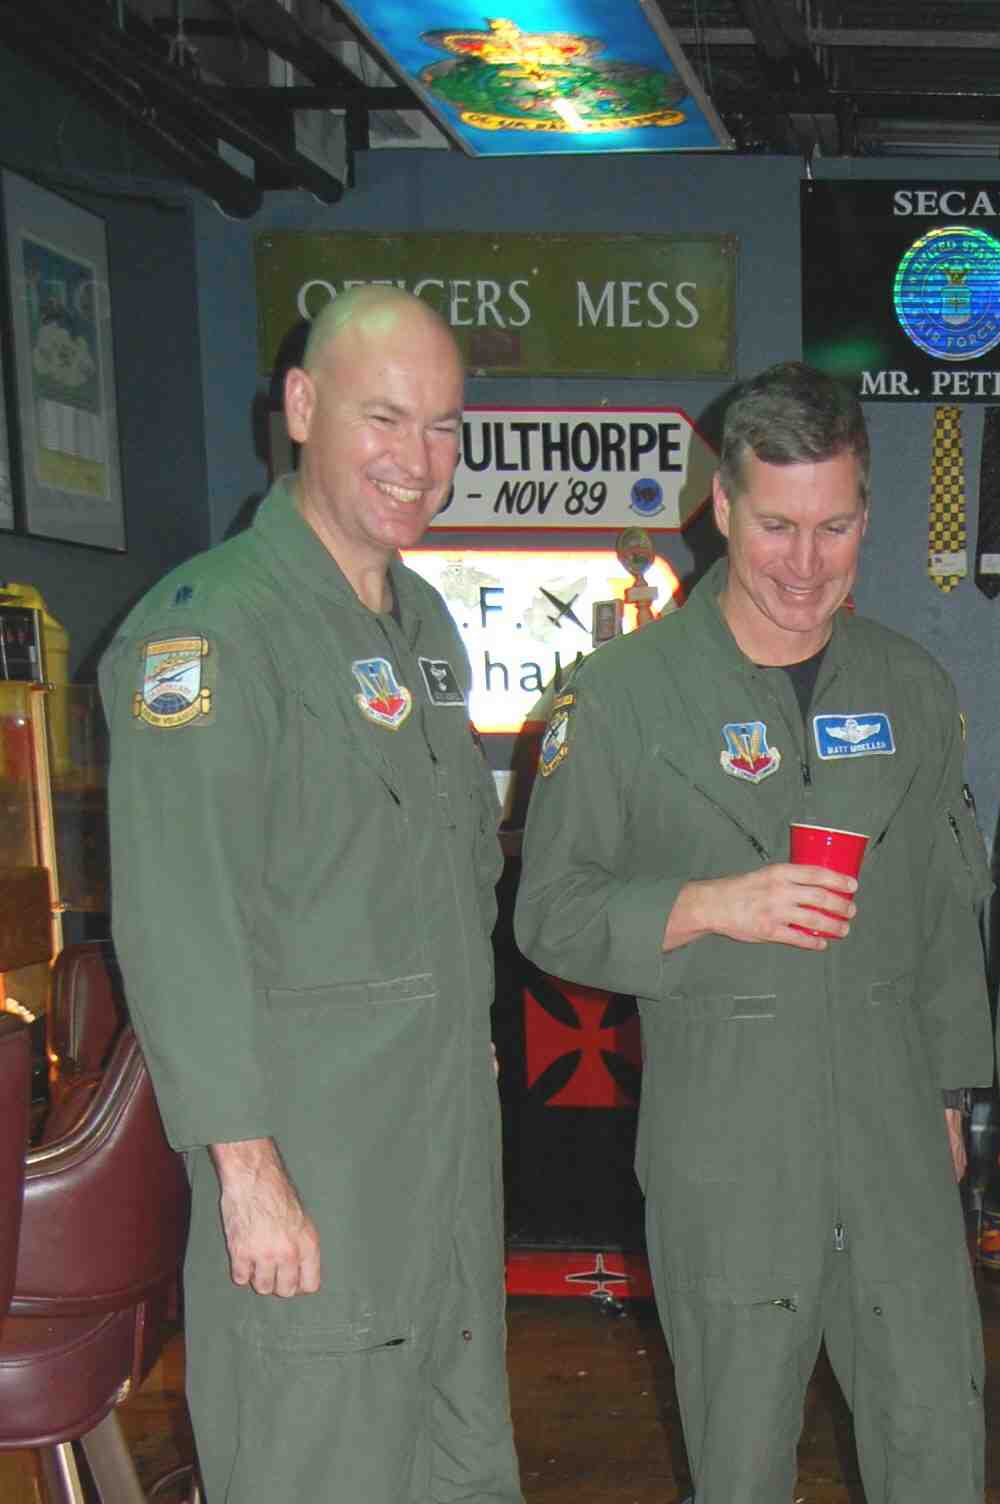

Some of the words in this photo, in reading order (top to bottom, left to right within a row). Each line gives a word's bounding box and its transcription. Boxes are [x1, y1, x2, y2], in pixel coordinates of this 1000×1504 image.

[297, 279, 530, 328] OERS
[576, 281, 699, 328] MESS
[860, 371, 919, 395] MR.
[458, 421, 682, 472] ULTHORPE
[494, 481, 559, 514] NOV
[564, 477, 607, 515] '89
